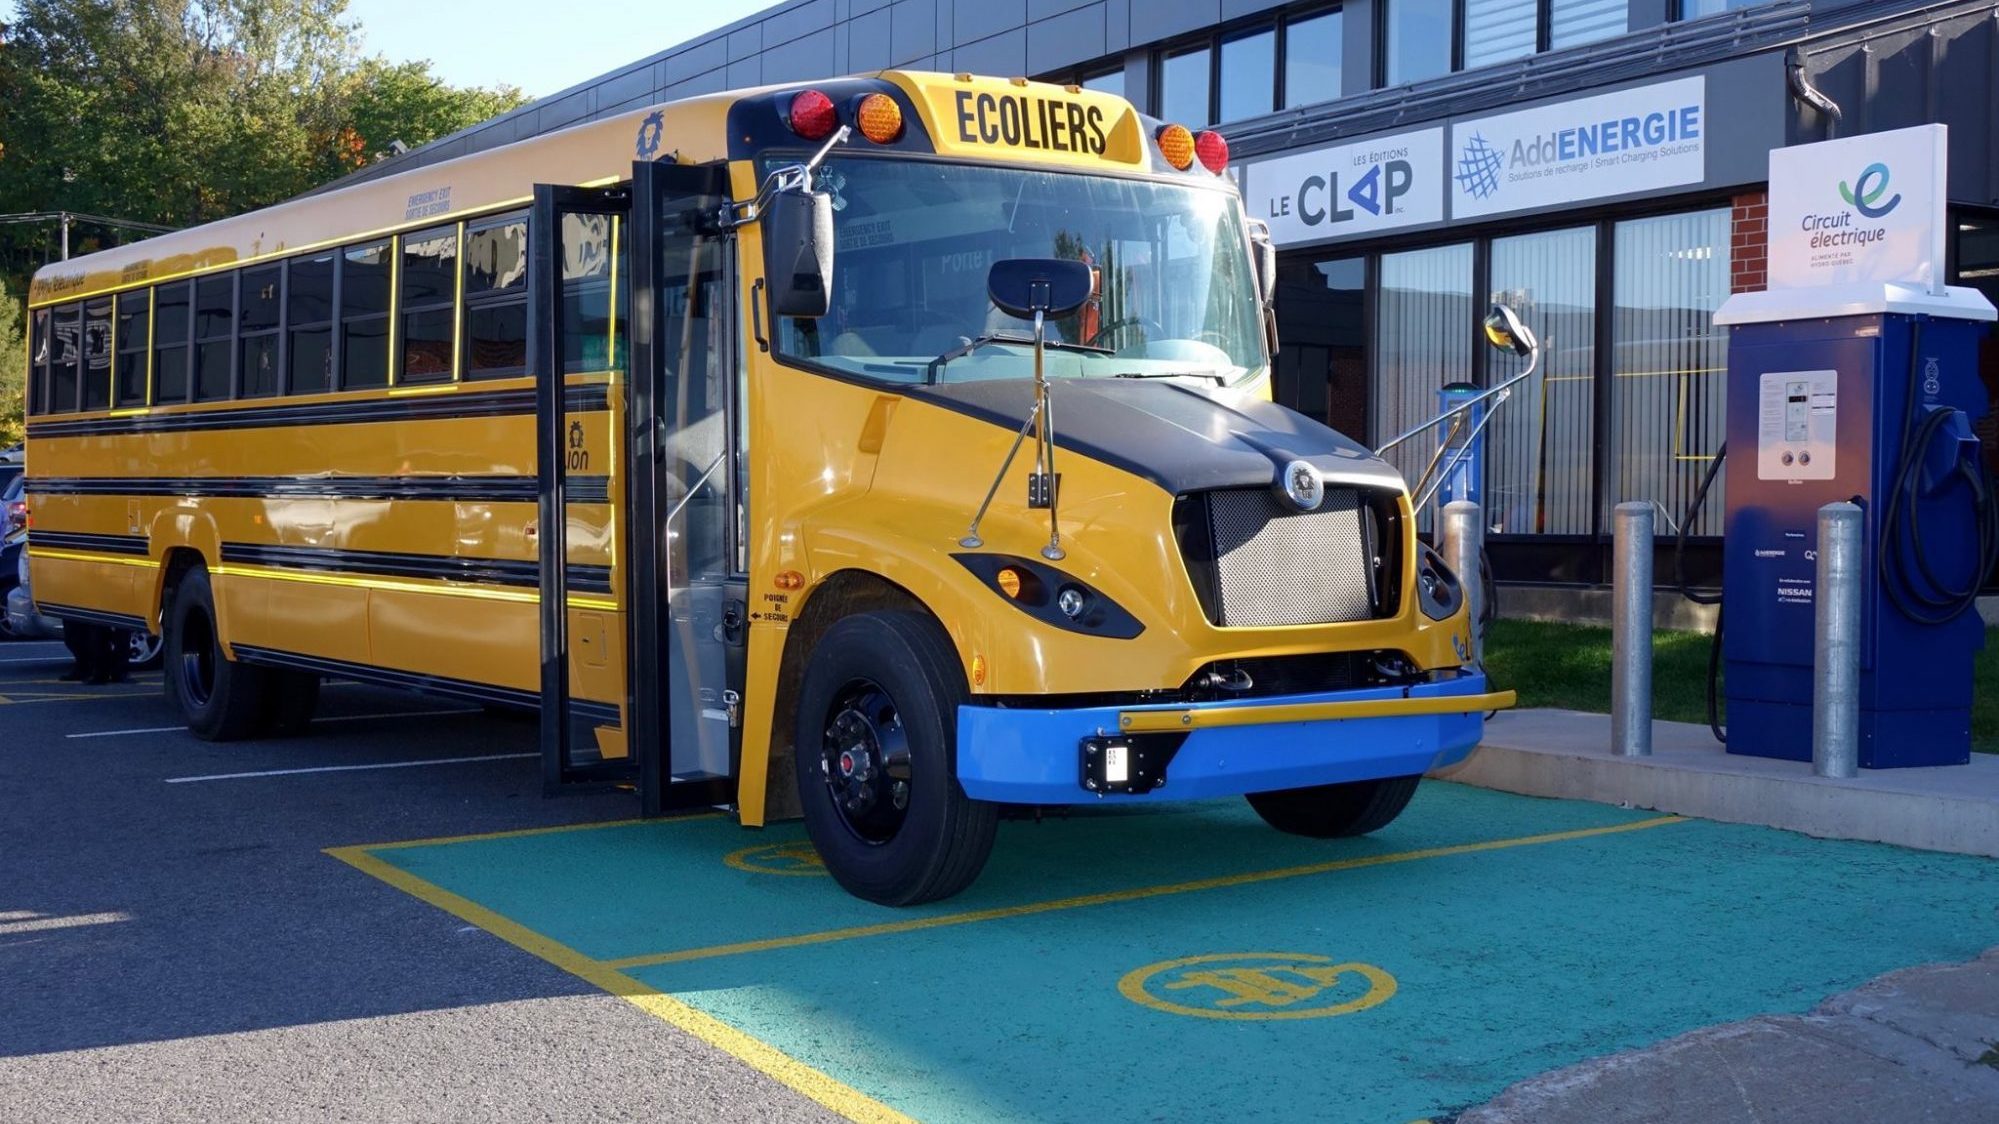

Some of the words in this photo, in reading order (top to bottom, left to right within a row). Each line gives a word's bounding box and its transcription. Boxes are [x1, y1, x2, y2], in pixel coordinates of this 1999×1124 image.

[955, 90, 1106, 155] ECOLIERS
[1508, 105, 1700, 170] AddENERGIE
[1353, 155, 1367, 166] LES
[1369, 147, 1408, 163] ÉDITIONS
[1508, 170, 1542, 182] Solutions
[1544, 167, 1553, 177] de
[1555, 161, 1588, 174] recharge
[1595, 155, 1620, 168] Smart
[1621, 151, 1658, 164] Charging
[1660, 143, 1699, 157] Solutions
[1270, 196, 1290, 218] LE
[1297, 159, 1413, 227] CLAP
[1801, 211, 1851, 232] Circuit
[1810, 227, 1886, 249] électrique
[1777, 587, 1812, 597] NISSAN
